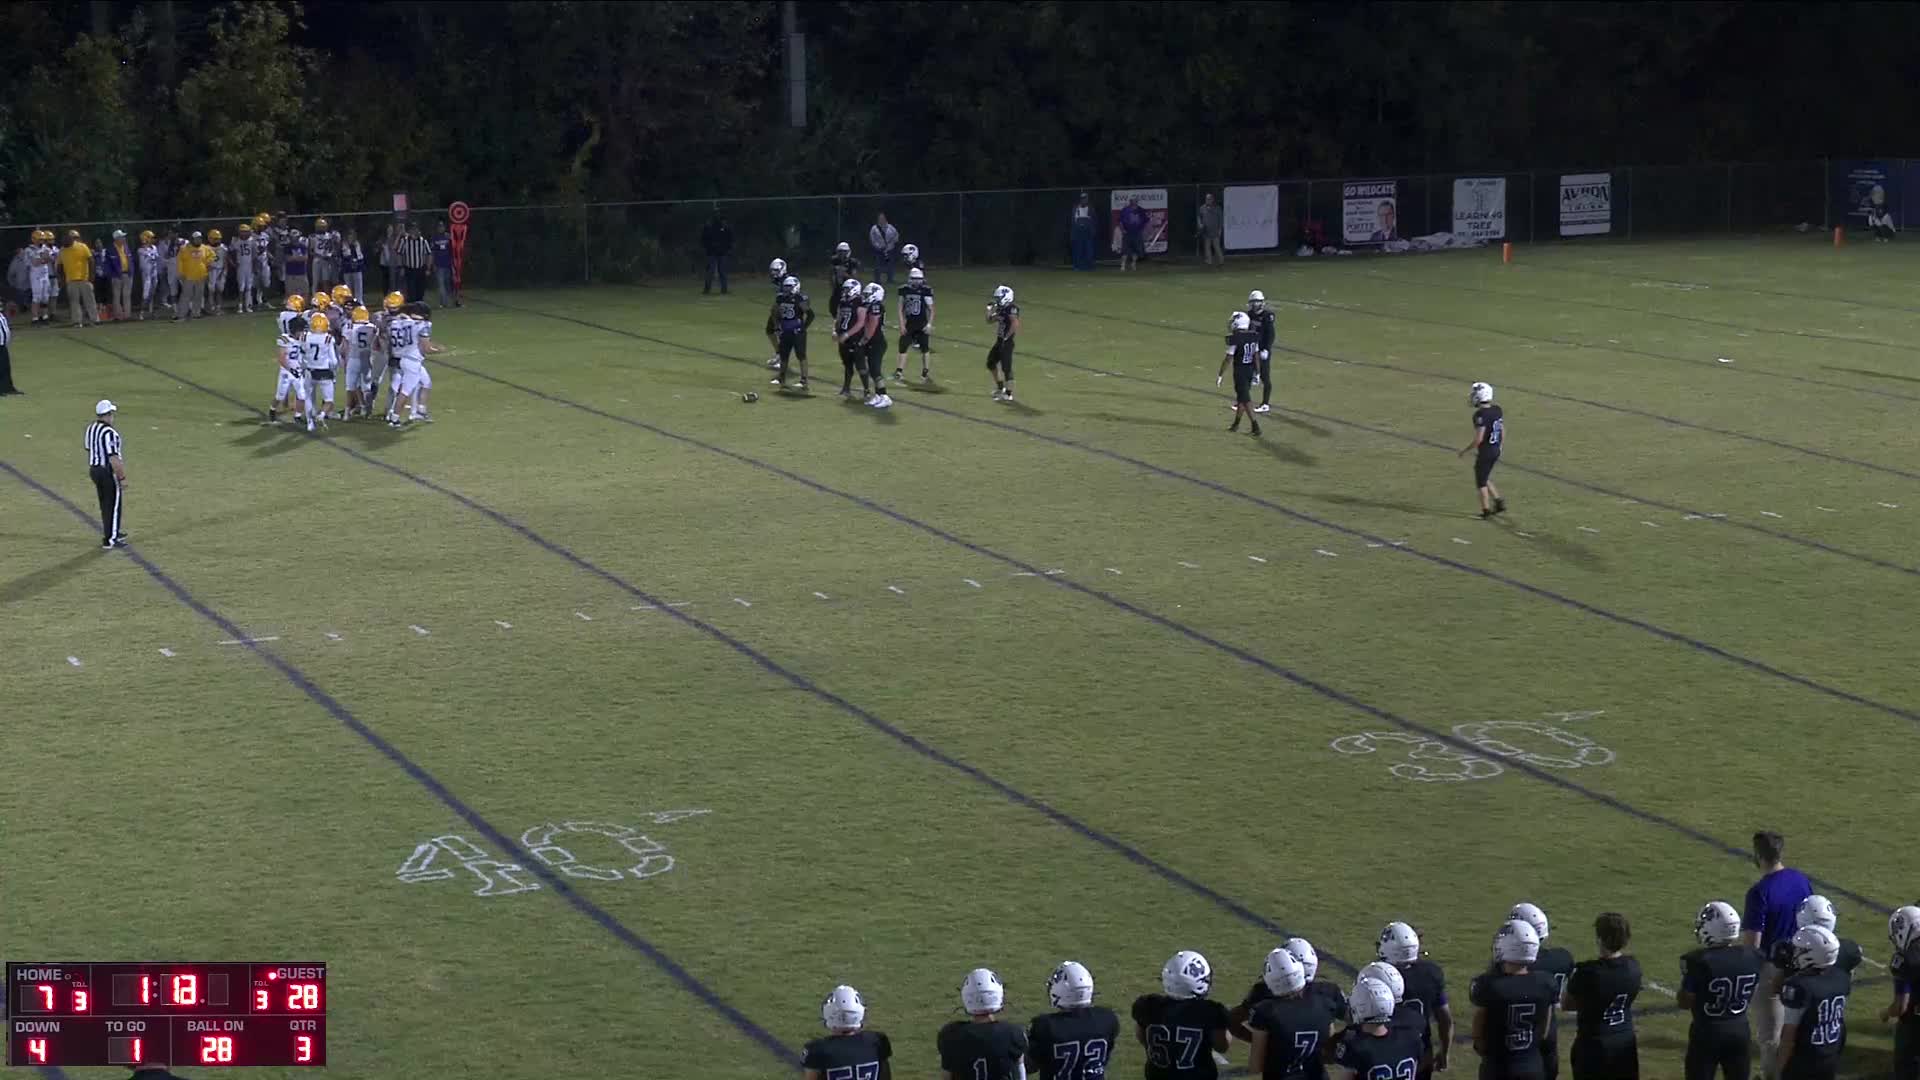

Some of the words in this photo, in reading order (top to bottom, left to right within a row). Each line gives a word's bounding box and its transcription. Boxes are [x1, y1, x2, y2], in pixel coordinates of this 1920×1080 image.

[1344, 186, 1356, 196] GO
[1455, 211, 1503, 221] LEARNNG
[310, 343, 320, 361] 7
[358, 332, 367, 349] 5
[1329, 719, 1617, 782] 30
[395, 820, 676, 897] 40
[1603, 993, 1629, 1026] 4
[1704, 973, 1759, 1017] 35
[1147, 1024, 1203, 1070] 67
[1505, 1003, 1536, 1051] 5
[1292, 1031, 1319, 1072] 7
